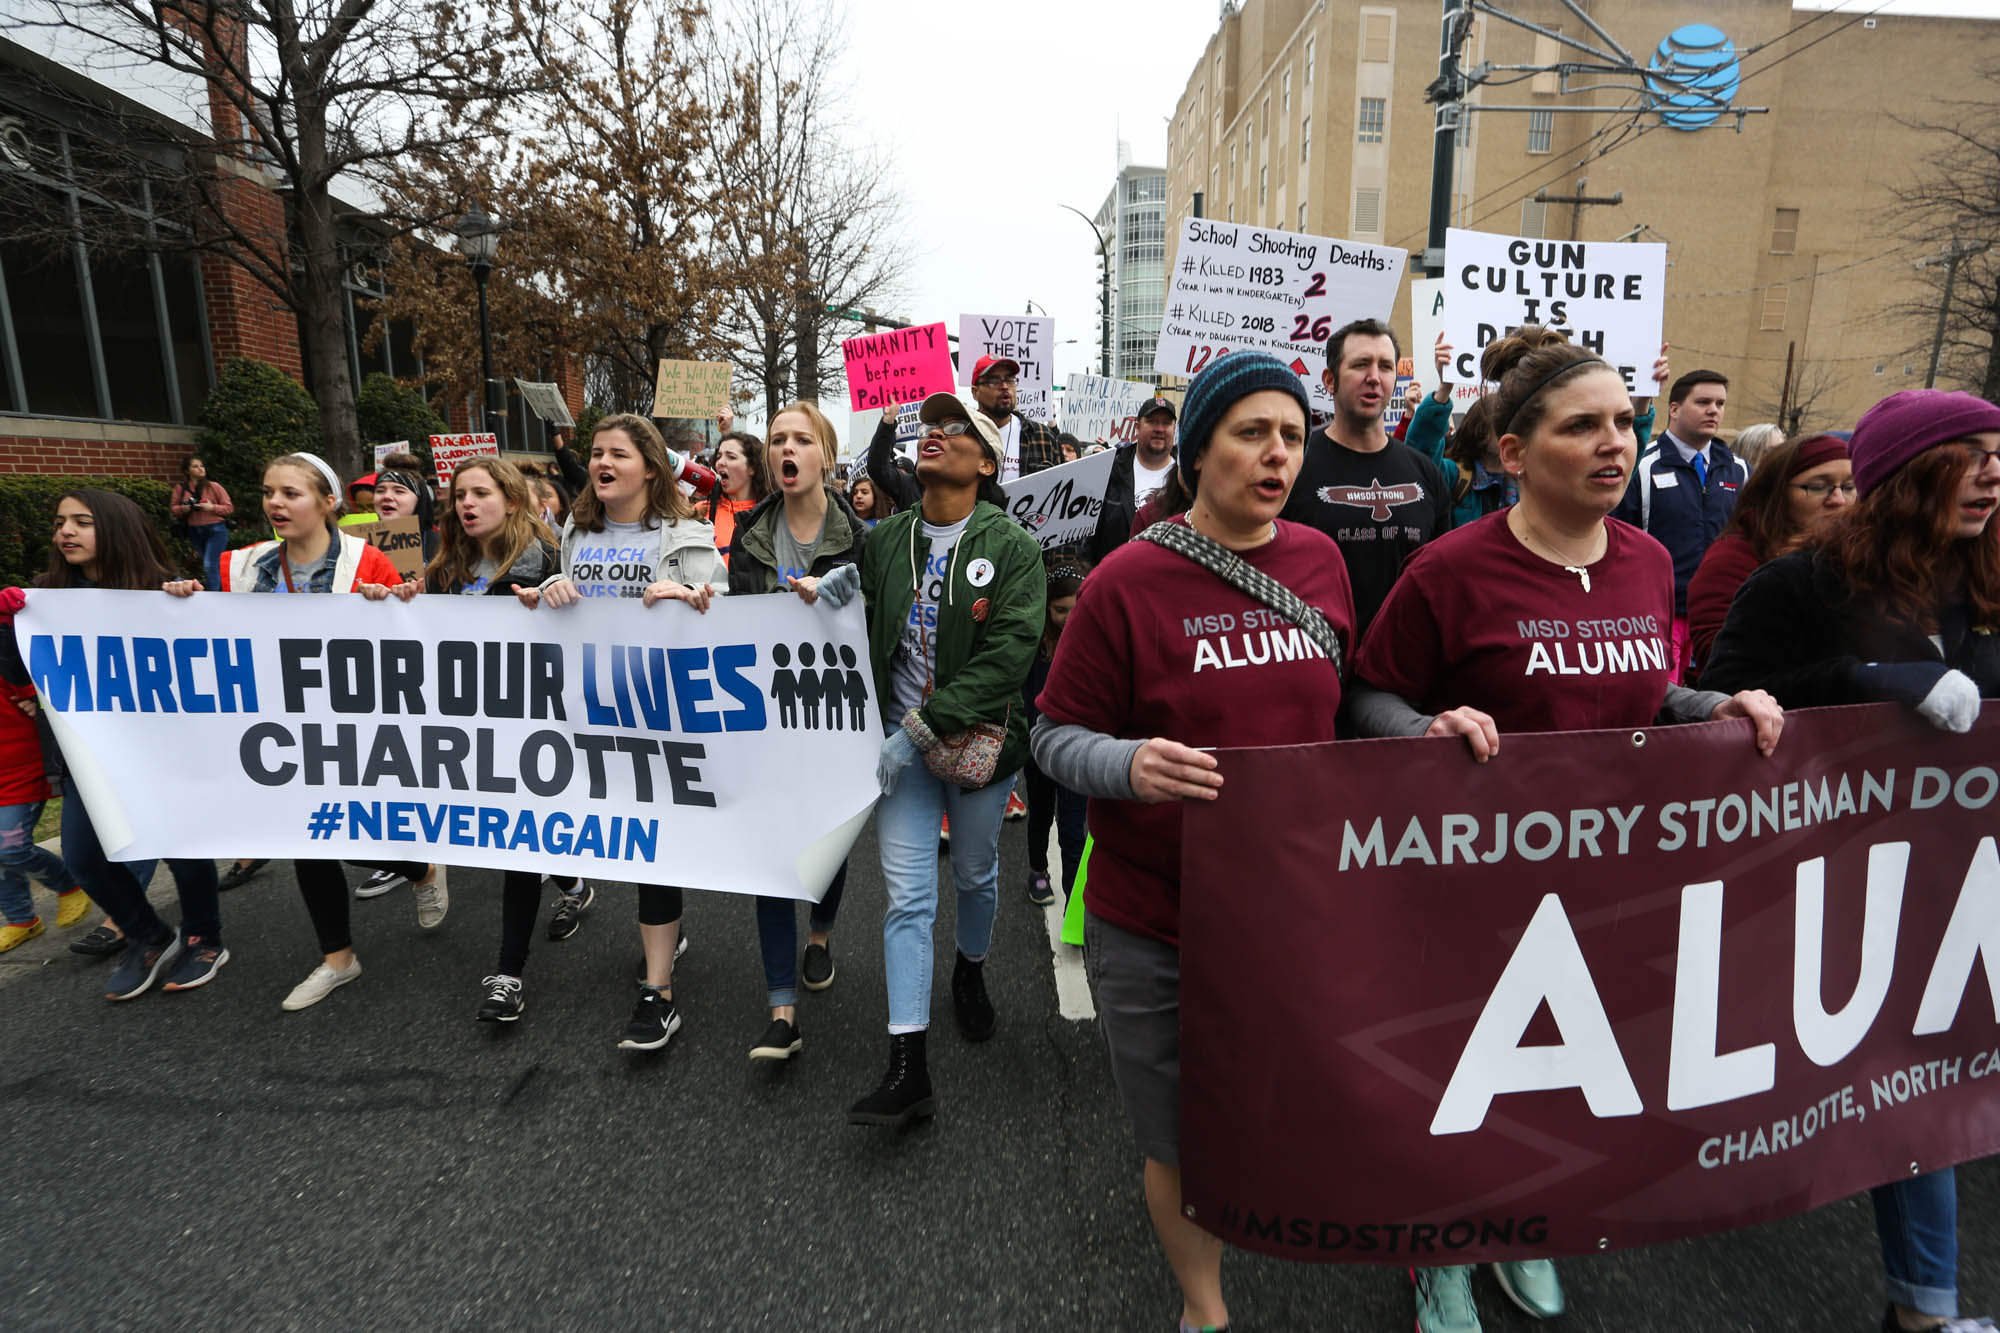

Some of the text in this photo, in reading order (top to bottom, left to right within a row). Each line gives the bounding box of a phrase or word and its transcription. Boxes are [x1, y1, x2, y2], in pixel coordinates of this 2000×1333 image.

[1188, 221, 1394, 272] School Shooting Deaths:
[1508, 240, 1586, 269] GUN
[1199, 255, 1245, 279] KILLED
[1249, 266, 1285, 287] 1983
[1304, 271, 1327, 299] 2
[1461, 264, 1642, 300] CULTURE
[1209, 285, 1223, 294] WAS
[1226, 286, 1234, 296] IN
[1237, 288, 1306, 310] KINDERGARTEN)
[1188, 303, 1235, 328] KILLED
[1241, 315, 1275, 333] 2018
[1289, 314, 1332, 343] 26
[1524, 299, 1567, 325] IS
[981, 318, 1040, 344] VOTE
[843, 327, 935, 362] HUMANITY
[983, 342, 1031, 359] THEM
[1195, 331, 1207, 341] MY
[1209, 333, 1255, 346] DAUGHTER
[1259, 339, 1268, 347] IN
[1271, 339, 1328, 358] KINDERGARTE
[663, 362, 730, 380] We Will Not
[864, 360, 916, 382] before
[660, 381, 728, 396] Let The NRA
[660, 394, 723, 407] Control The
[857, 386, 926, 408] Politics
[666, 404, 715, 418] Narrative
[897, 413, 917, 424] FOR
[1109, 400, 1123, 415] AN
[1384, 411, 1401, 422] LIV
[899, 424, 915, 434] LIV
[1037, 478, 1103, 520] More
[1337, 527, 1377, 541] CLASS
[1382, 526, 1399, 540] OF
[575, 546, 646, 562] MARCH
[573, 564, 653, 583] FOR OUR
[1183, 613, 1236, 637] MSD
[1517, 614, 1658, 639] MSD STRONG
[1193, 628, 1329, 673] ALUMN
[1524, 637, 1667, 676] ALUMNI
[29, 634, 767, 733] MARCH FOR OUR LIVES
[239, 721, 717, 808] CHARLOTTE
[307, 801, 659, 863] #NEVERAGAIN
[1337, 804, 1646, 872] MARJORY
[1657, 767, 1896, 851] STONEMAN
[1698, 1086, 1866, 1169] CHARLOTTE,
[1870, 1057, 1962, 1111] NORTH
[1219, 1202, 1550, 1254] #MSDSTRONG
